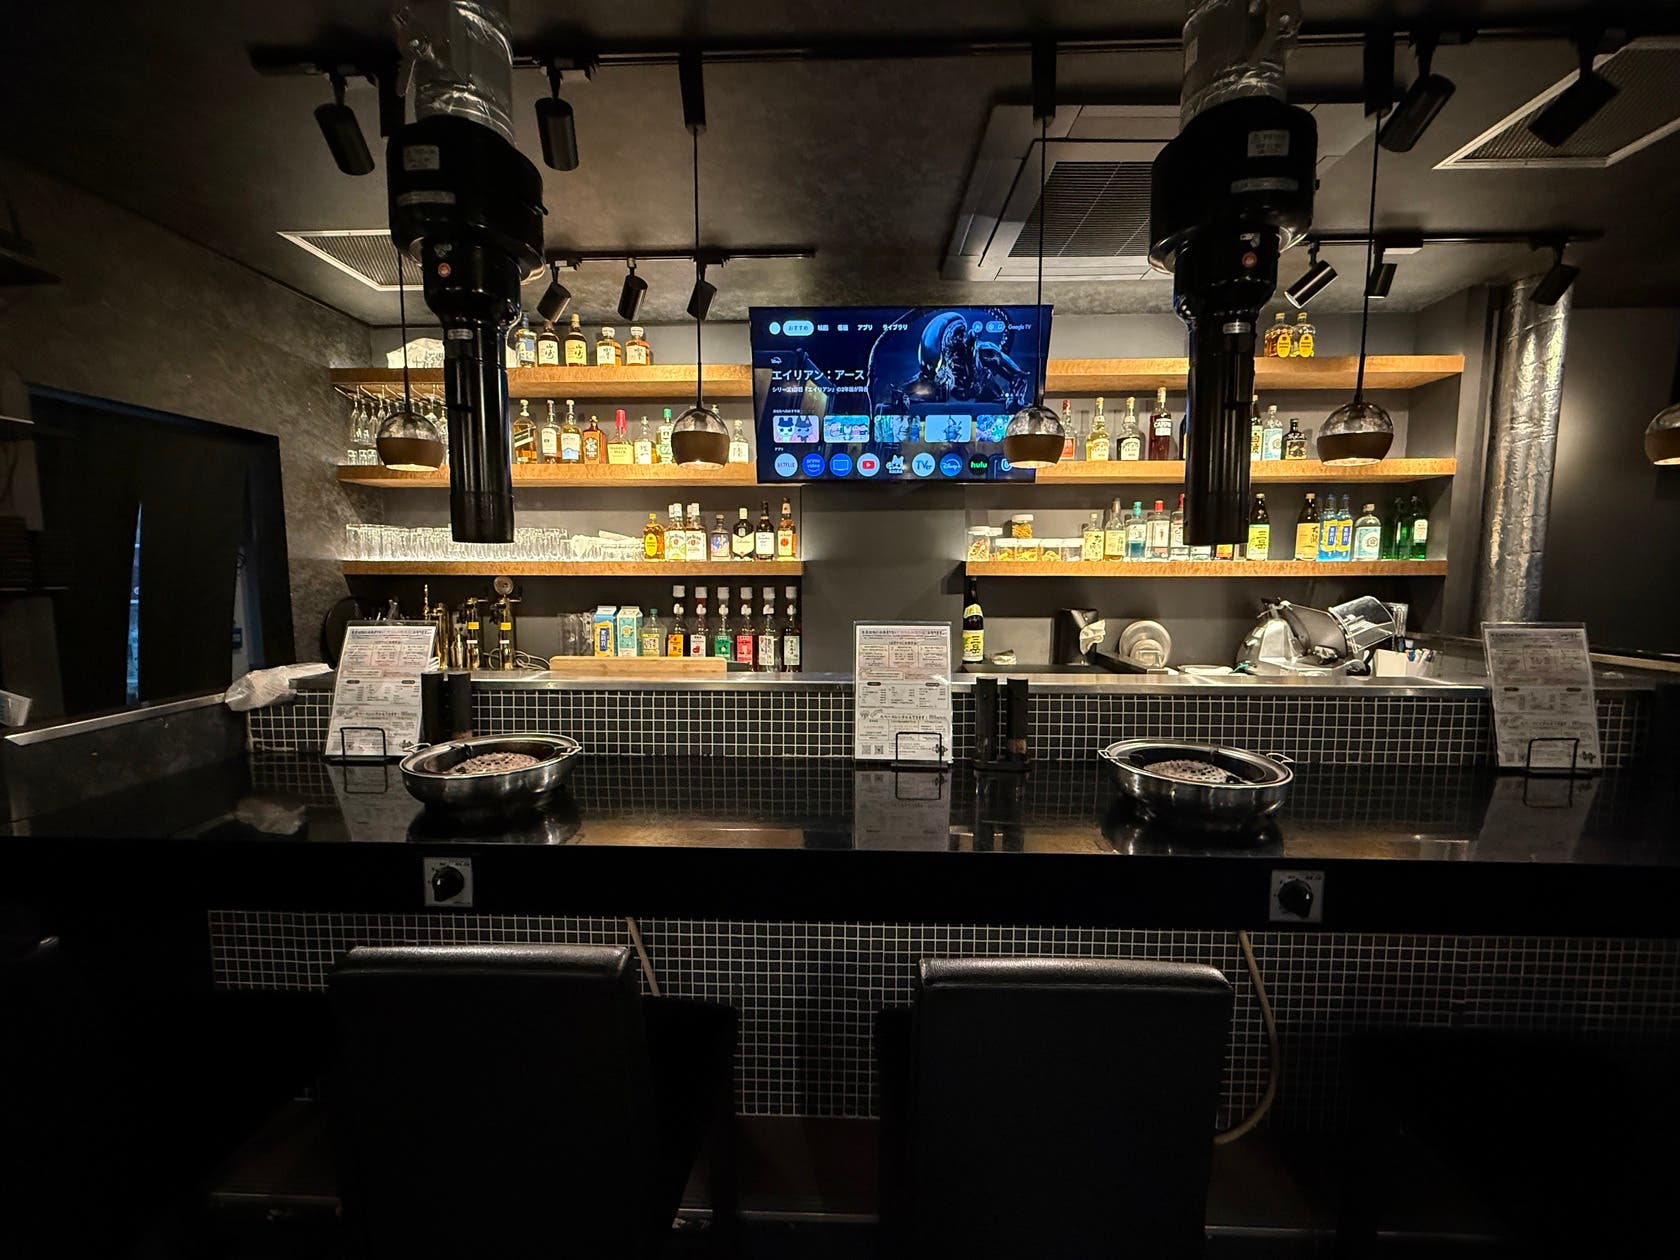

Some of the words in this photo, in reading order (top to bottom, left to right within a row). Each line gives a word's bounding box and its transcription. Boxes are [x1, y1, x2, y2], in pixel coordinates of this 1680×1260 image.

[882, 323, 908, 331] ライブラリ
[772, 369, 865, 380] エイリアン：アース
